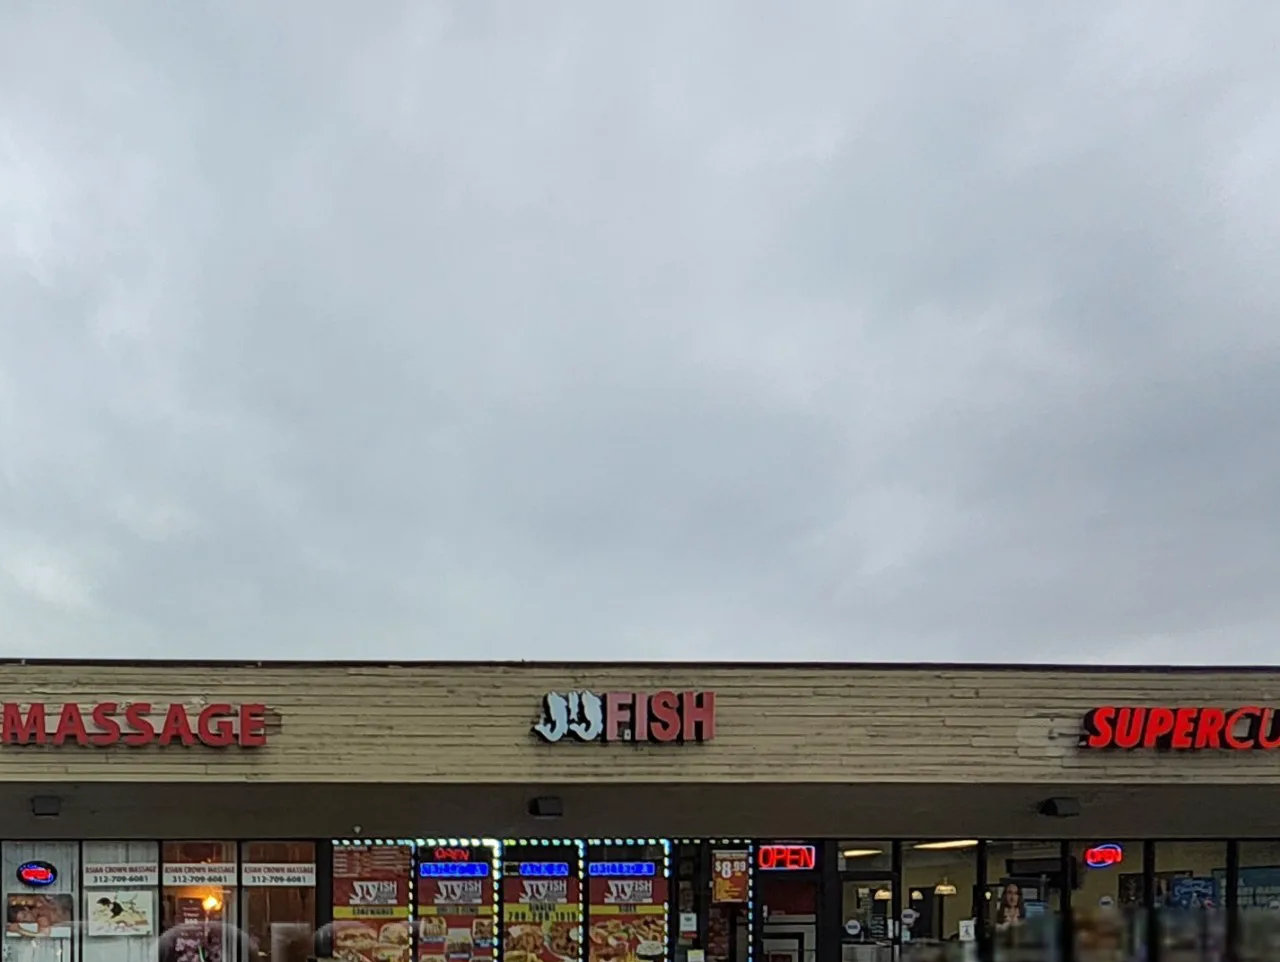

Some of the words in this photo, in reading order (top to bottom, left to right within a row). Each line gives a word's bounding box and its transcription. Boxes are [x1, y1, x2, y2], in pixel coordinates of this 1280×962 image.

[0, 702, 267, 747] MASSAGE
[606, 690, 716, 742] FISH
[758, 846, 815, 869] OPEN
